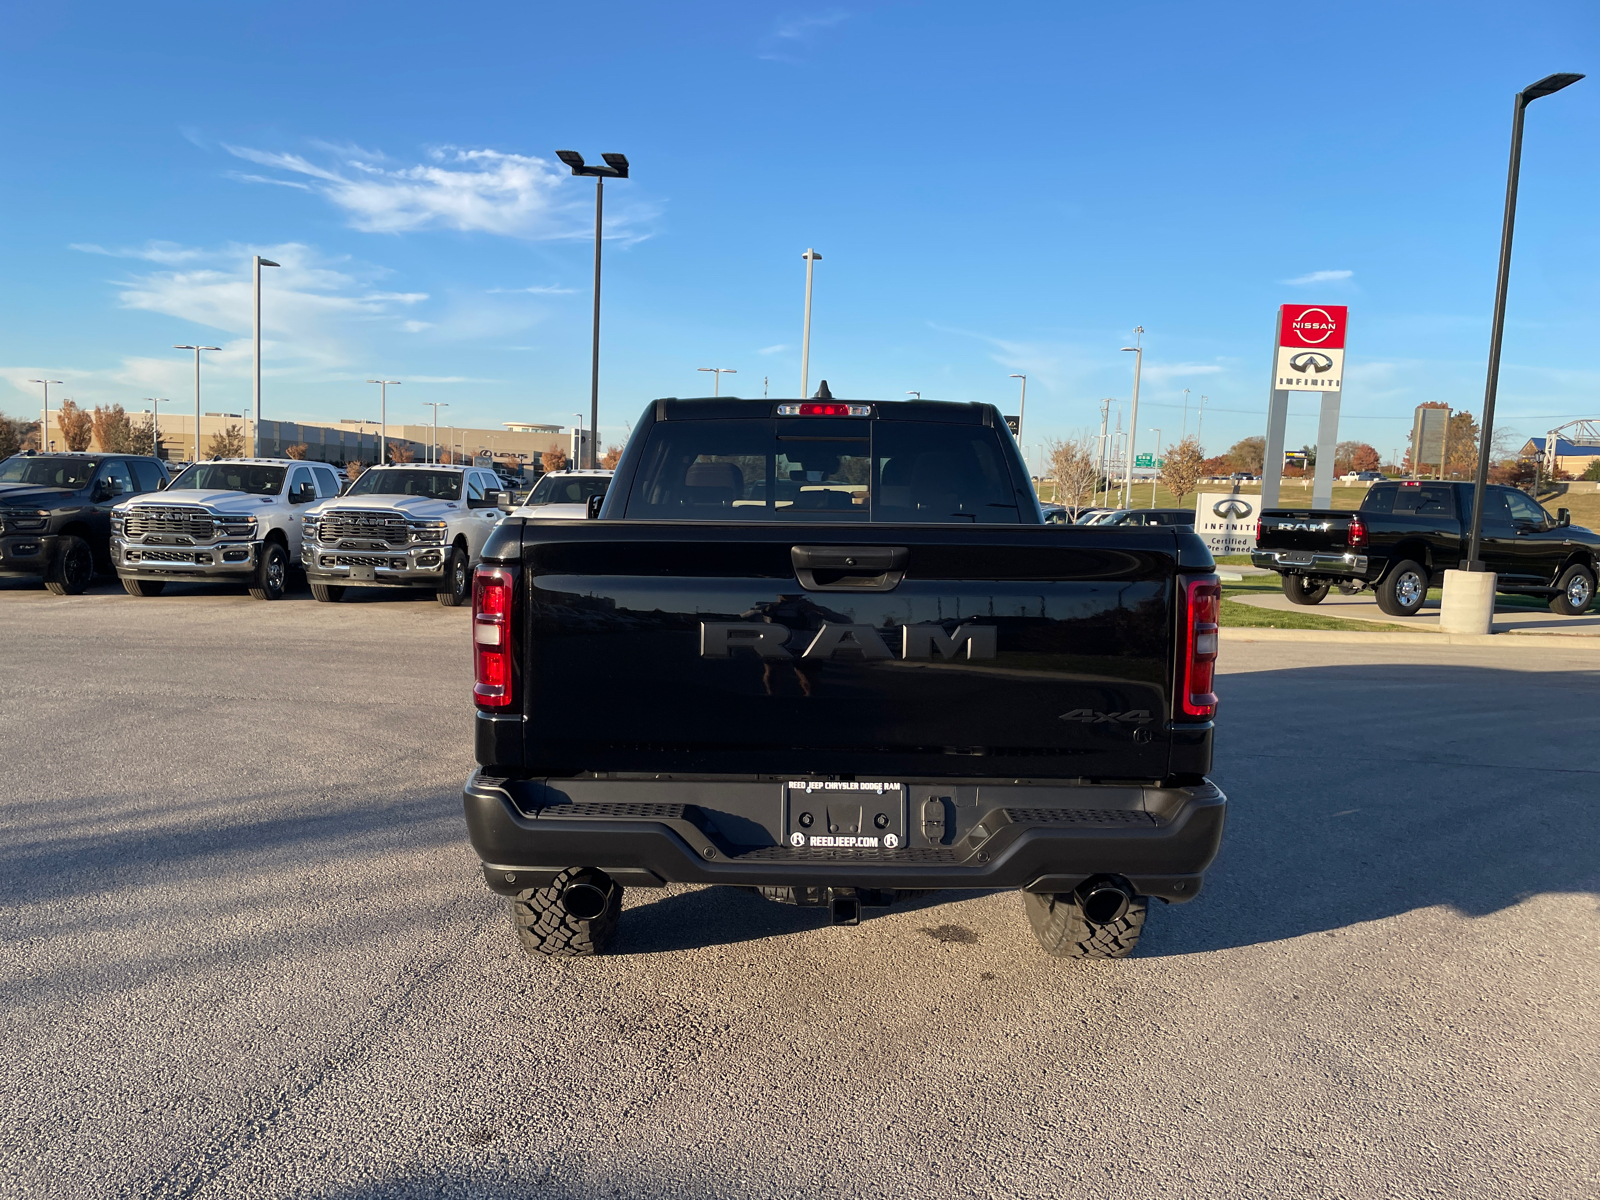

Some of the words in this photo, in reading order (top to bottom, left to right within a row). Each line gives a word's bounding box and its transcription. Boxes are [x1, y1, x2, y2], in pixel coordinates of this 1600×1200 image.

[1292, 322, 1336, 330] NISSAN
[1279, 377, 1340, 387] INFINITI
[1204, 522, 1257, 532] INFINITI
[1277, 522, 1330, 533] RAM
[1211, 537, 1248, 546] Certified
[700, 621, 998, 660] RAM
[788, 781, 806, 789] REED
[807, 781, 824, 790] JEEP
[824, 781, 859, 790] CHRYSLER
[860, 782, 883, 790] DODGE
[884, 783, 900, 791] RAM
[809, 836, 879, 848] REEDJEEP.COM
